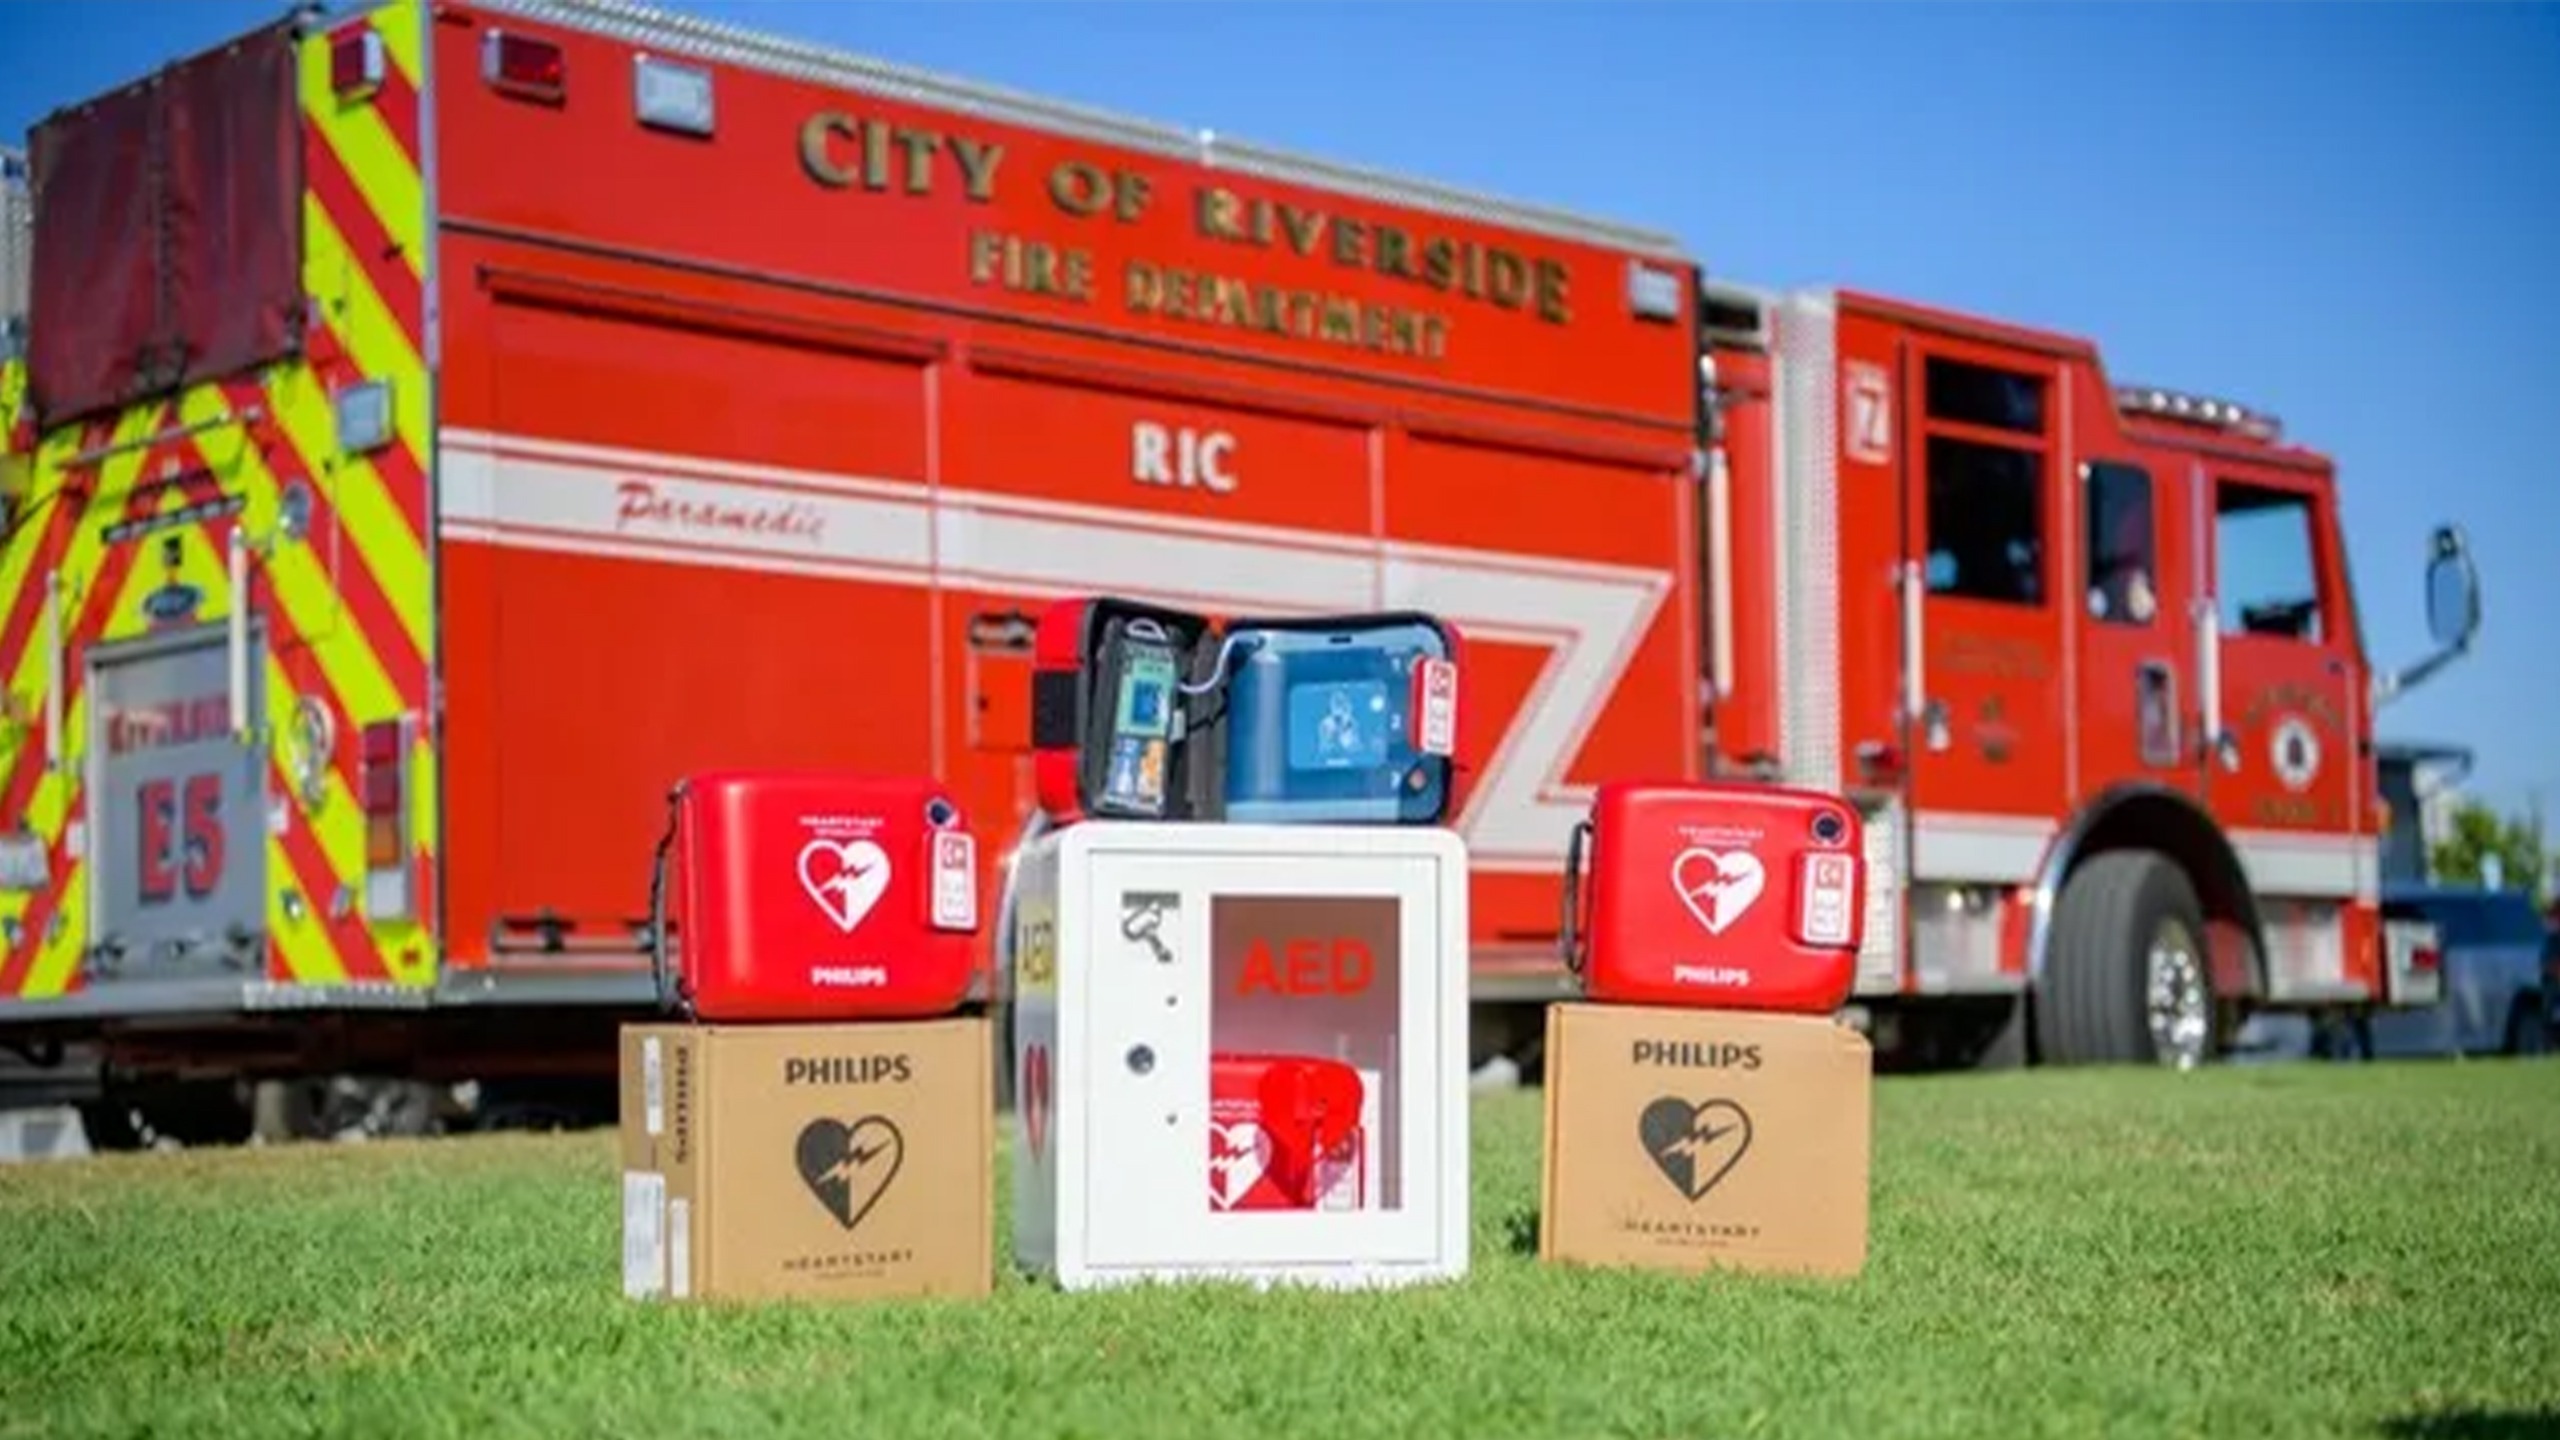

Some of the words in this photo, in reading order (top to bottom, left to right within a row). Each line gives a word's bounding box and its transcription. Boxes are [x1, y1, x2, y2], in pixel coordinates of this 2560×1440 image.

[797, 109, 1005, 201] CITY
[1048, 160, 1151, 222] OF
[1196, 188, 1573, 324] RIVERSIDE
[969, 229, 1093, 301] FIRE
[1126, 259, 1452, 359] DEPARTMENT
[1131, 420, 1239, 494] RIC
[615, 479, 826, 544] Paramedic
[138, 772, 229, 906] E5
[810, 965, 888, 987] PHILIPS
[1236, 937, 1374, 996] AED
[1672, 965, 1750, 987] PHILIPS
[784, 1053, 912, 1086] PHILIPS
[1632, 1041, 1763, 1071] PHILIPS
